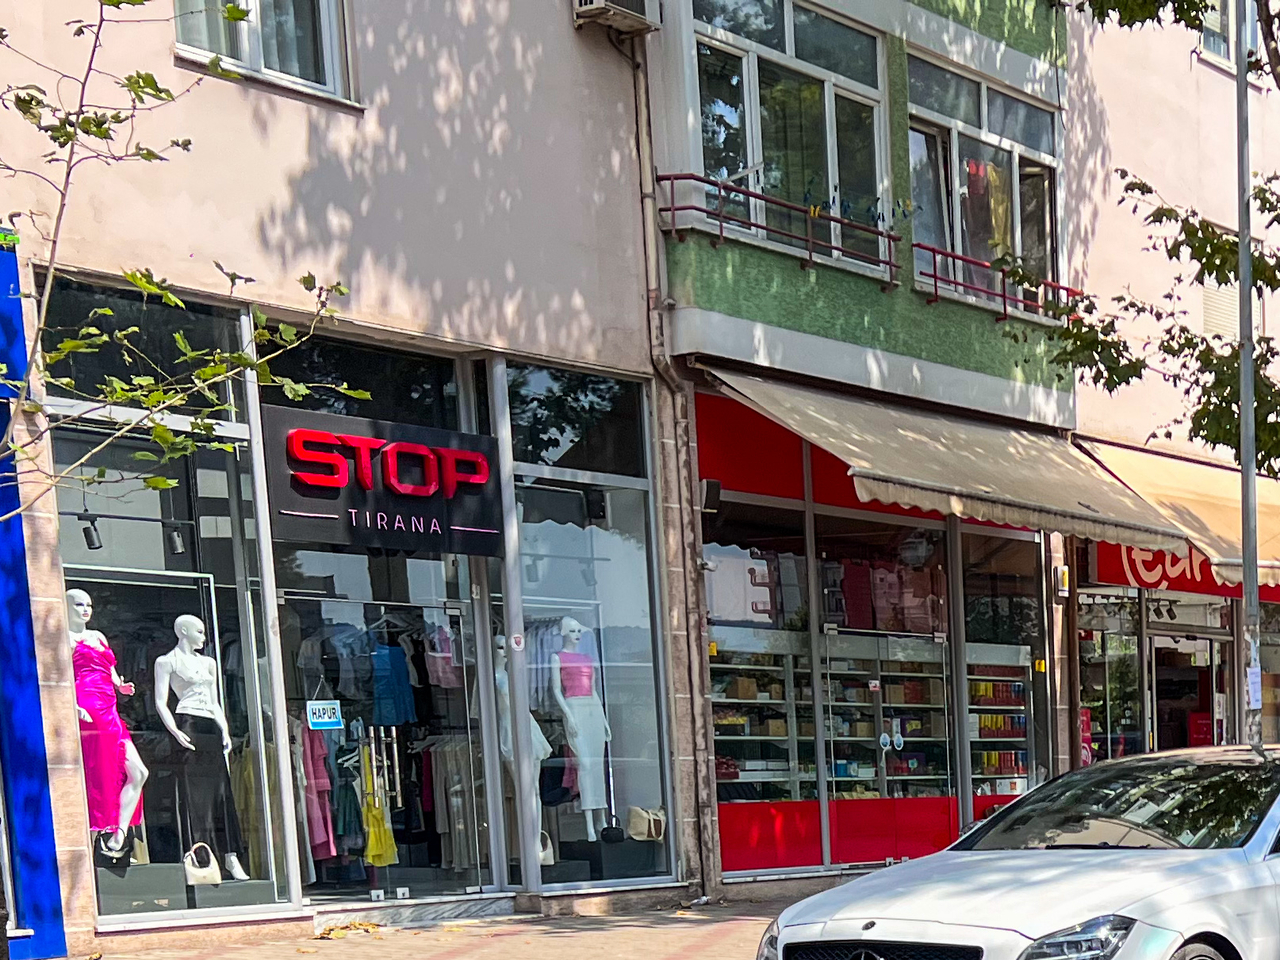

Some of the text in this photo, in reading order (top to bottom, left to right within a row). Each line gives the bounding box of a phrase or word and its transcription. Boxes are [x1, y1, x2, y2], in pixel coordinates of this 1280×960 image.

[286, 428, 490, 499] STOP
[348, 509, 442, 535] TIRANA
[311, 707, 338, 720] HAPUR
